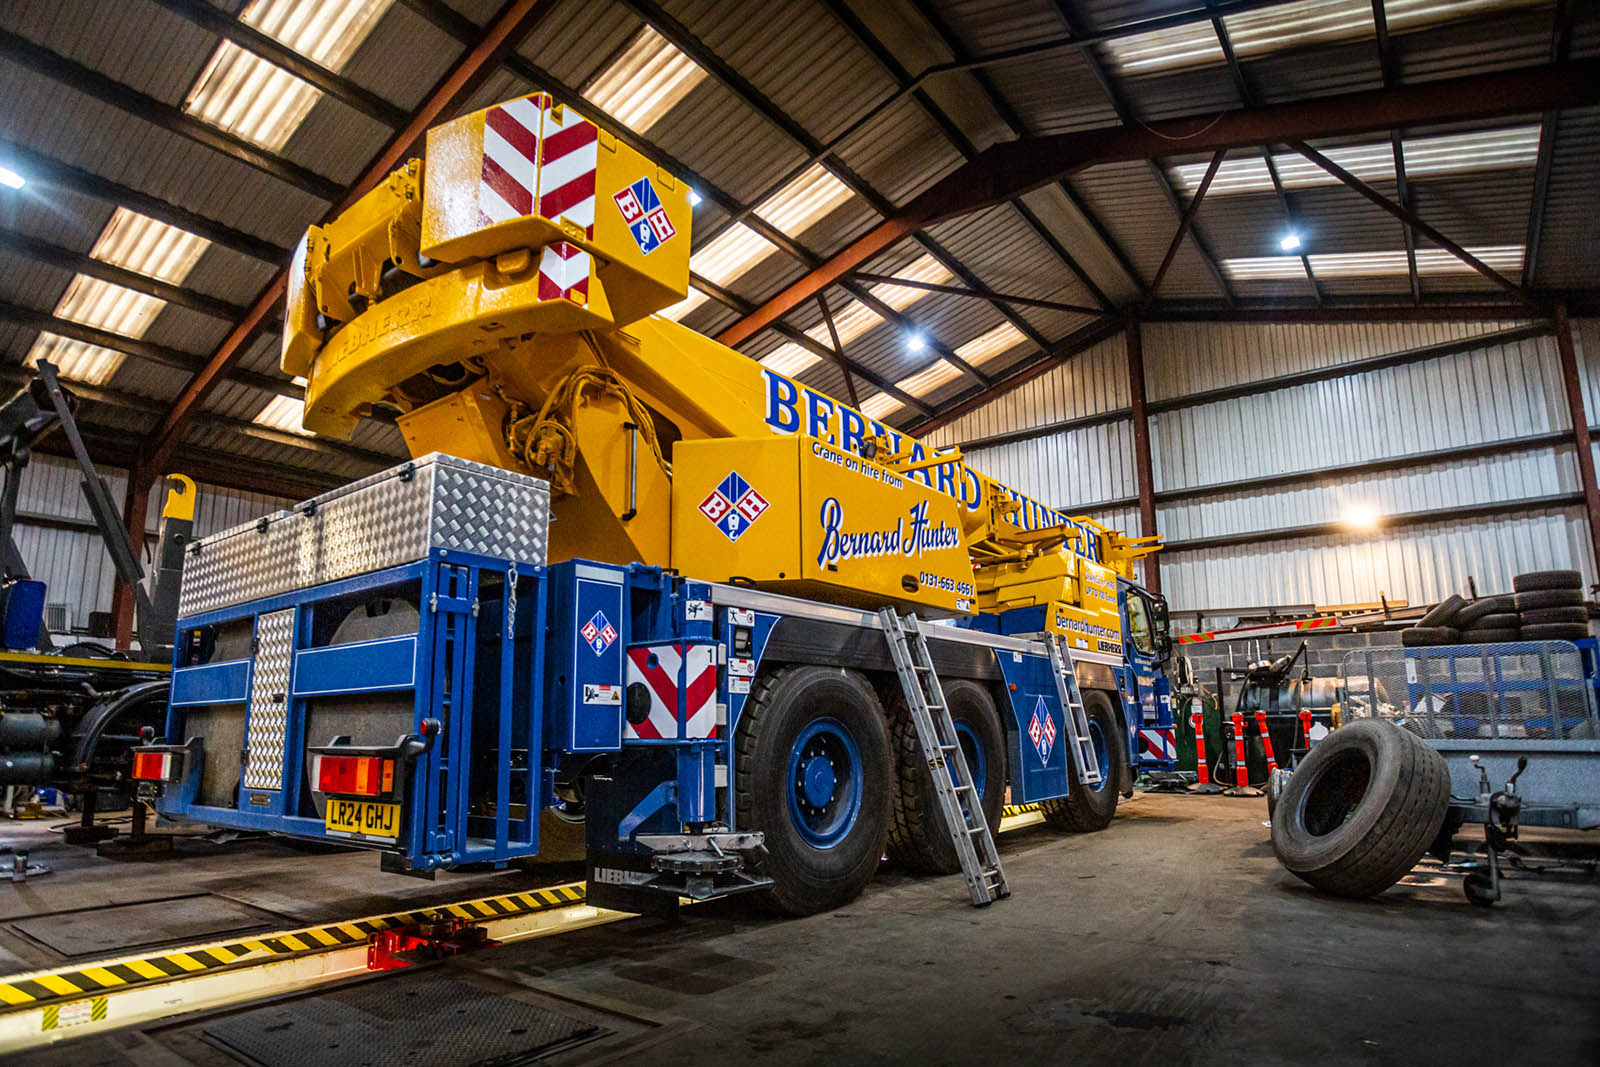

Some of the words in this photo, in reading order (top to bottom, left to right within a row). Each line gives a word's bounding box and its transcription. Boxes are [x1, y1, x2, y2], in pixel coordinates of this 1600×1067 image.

[813, 441, 843, 464] Crane
[846, 457, 858, 470] on
[861, 463, 879, 480] hire
[882, 471, 903, 489] from
[817, 497, 903, 571] Bernard
[903, 500, 960, 558] Hunter
[920, 571, 955, 592] 0131-663
[957, 583, 974, 597] 4661
[1056, 610, 1121, 641] bernardhunter.com
[707, 648, 713, 663] 1
[1097, 640, 1122, 655] LIEBHERR
[331, 801, 362, 827] LR24
[366, 804, 394, 830] GHJ
